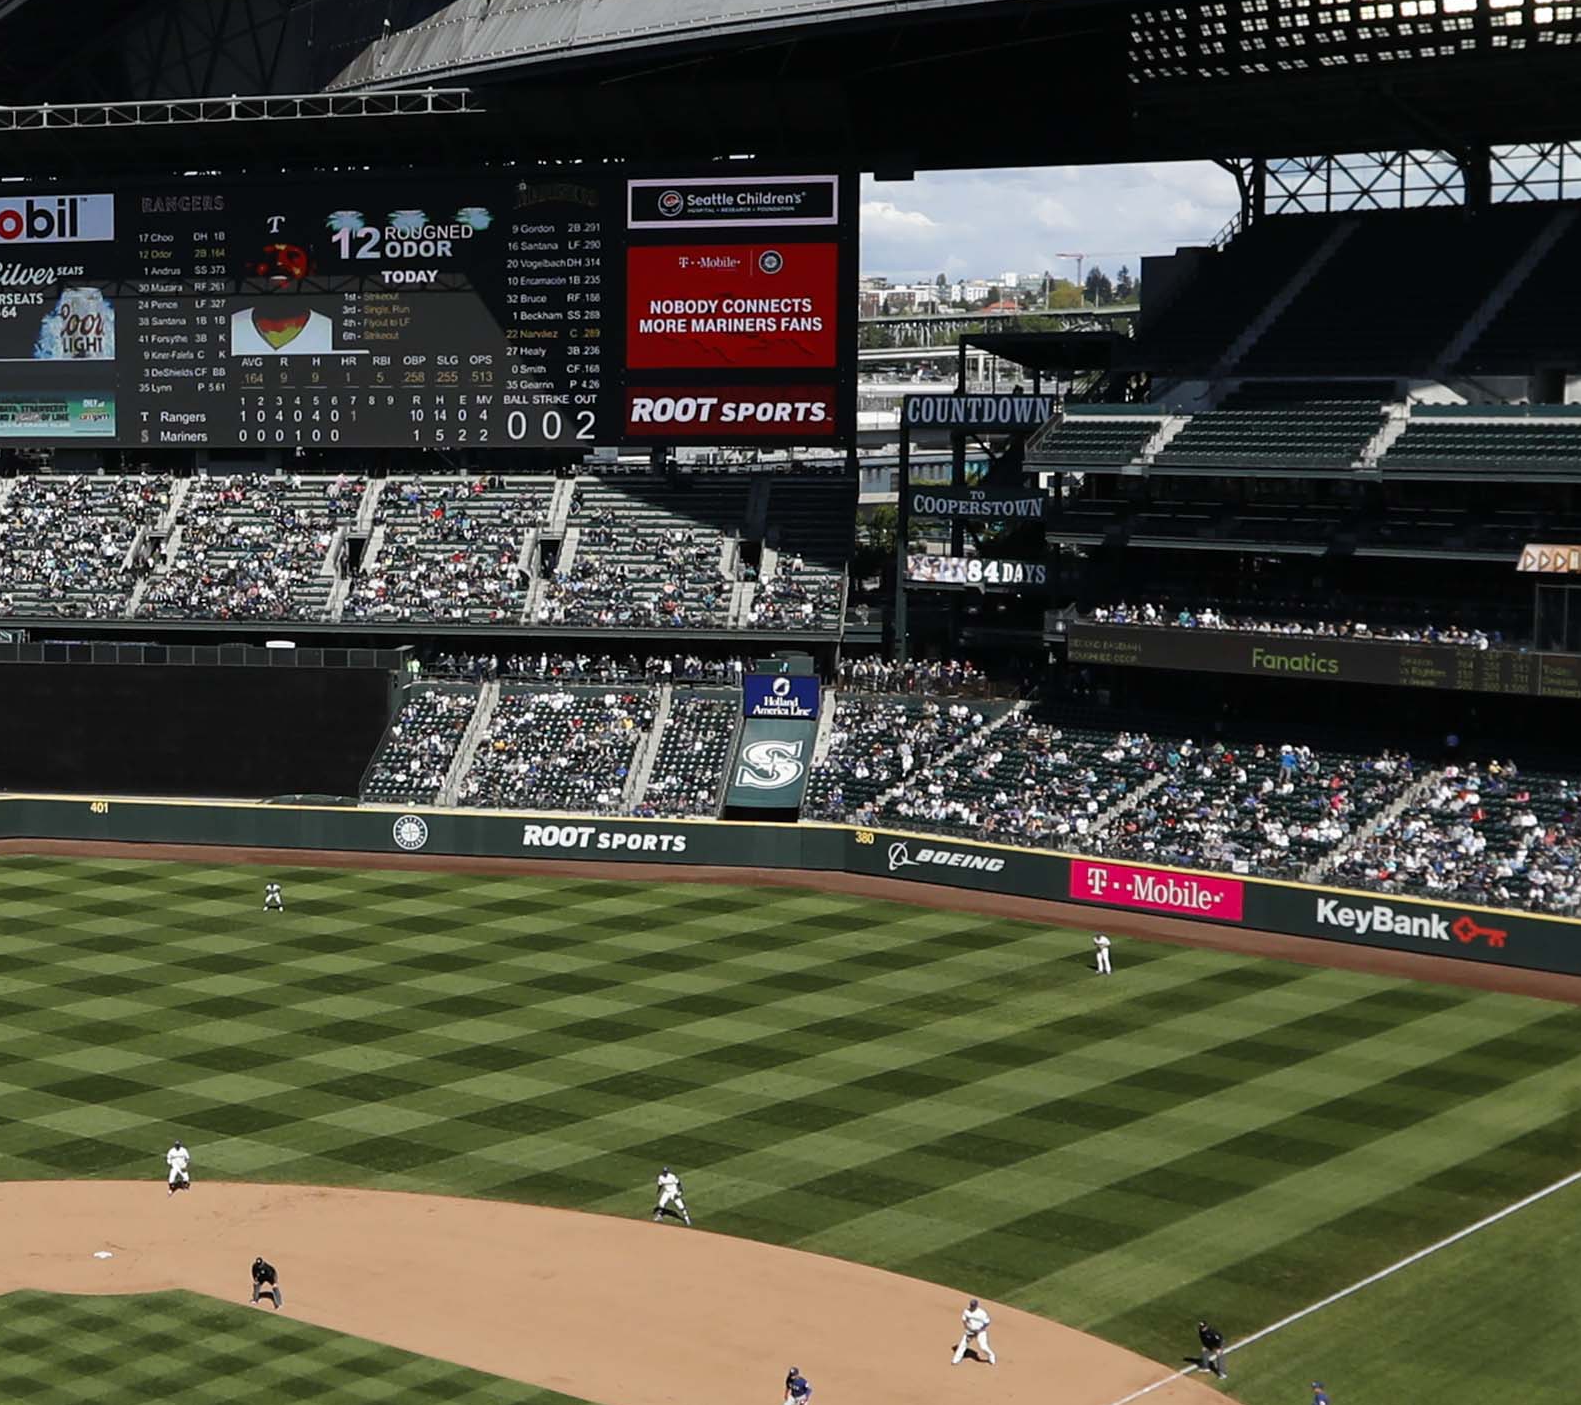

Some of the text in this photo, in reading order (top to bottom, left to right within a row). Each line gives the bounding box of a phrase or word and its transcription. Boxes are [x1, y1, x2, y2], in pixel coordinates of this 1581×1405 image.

[142, 195, 224, 213] RANGERS
[687, 192, 802, 206] Seattle Children's
[520, 224, 555, 233] Gordon
[151, 234, 174, 242] Choo
[332, 225, 473, 259] 12 ROUGNED
[385, 240, 453, 257] ODOR
[520, 241, 558, 250] Santana
[57, 266, 84, 275] SEATS
[381, 270, 438, 284] TODAY
[151, 301, 178, 309] Pence
[520, 294, 547, 303] Bruce
[650, 298, 812, 315] NOBODY CONNECTS
[151, 317, 186, 325] Santana
[520, 311, 563, 320] Beckham
[639, 317, 823, 334] MORE MARINERS FANS
[62, 337, 103, 353] LIGHT
[520, 347, 547, 357] Healy
[241, 355, 493, 367] AVG HR RBI OBP SLG OPS
[520, 364, 547, 374] Smith
[151, 383, 172, 393] Lynn
[503, 395, 597, 404] BALL STRIKE OUT
[631, 397, 826, 423] ROOT SPORTS
[907, 397, 1051, 424] COUNTDOWN
[160, 411, 206, 425] Rangers
[507, 411, 596, 440] 0 0 2
[160, 431, 208, 442] Mariners
[970, 491, 985, 500] TO
[913, 494, 1044, 516] COOPERSTOWN
[967, 559, 1046, 583] 84 DAYS
[1252, 648, 1339, 674] Fanatics
[764, 696, 798, 707] Holland
[752, 705, 789, 716] America
[90, 802, 108, 813] 401
[522, 824, 686, 852] ROOT SPORTS
[855, 831, 875, 845] 380
[916, 848, 1005, 872] BOEING
[1316, 898, 1450, 942] KeyBank
